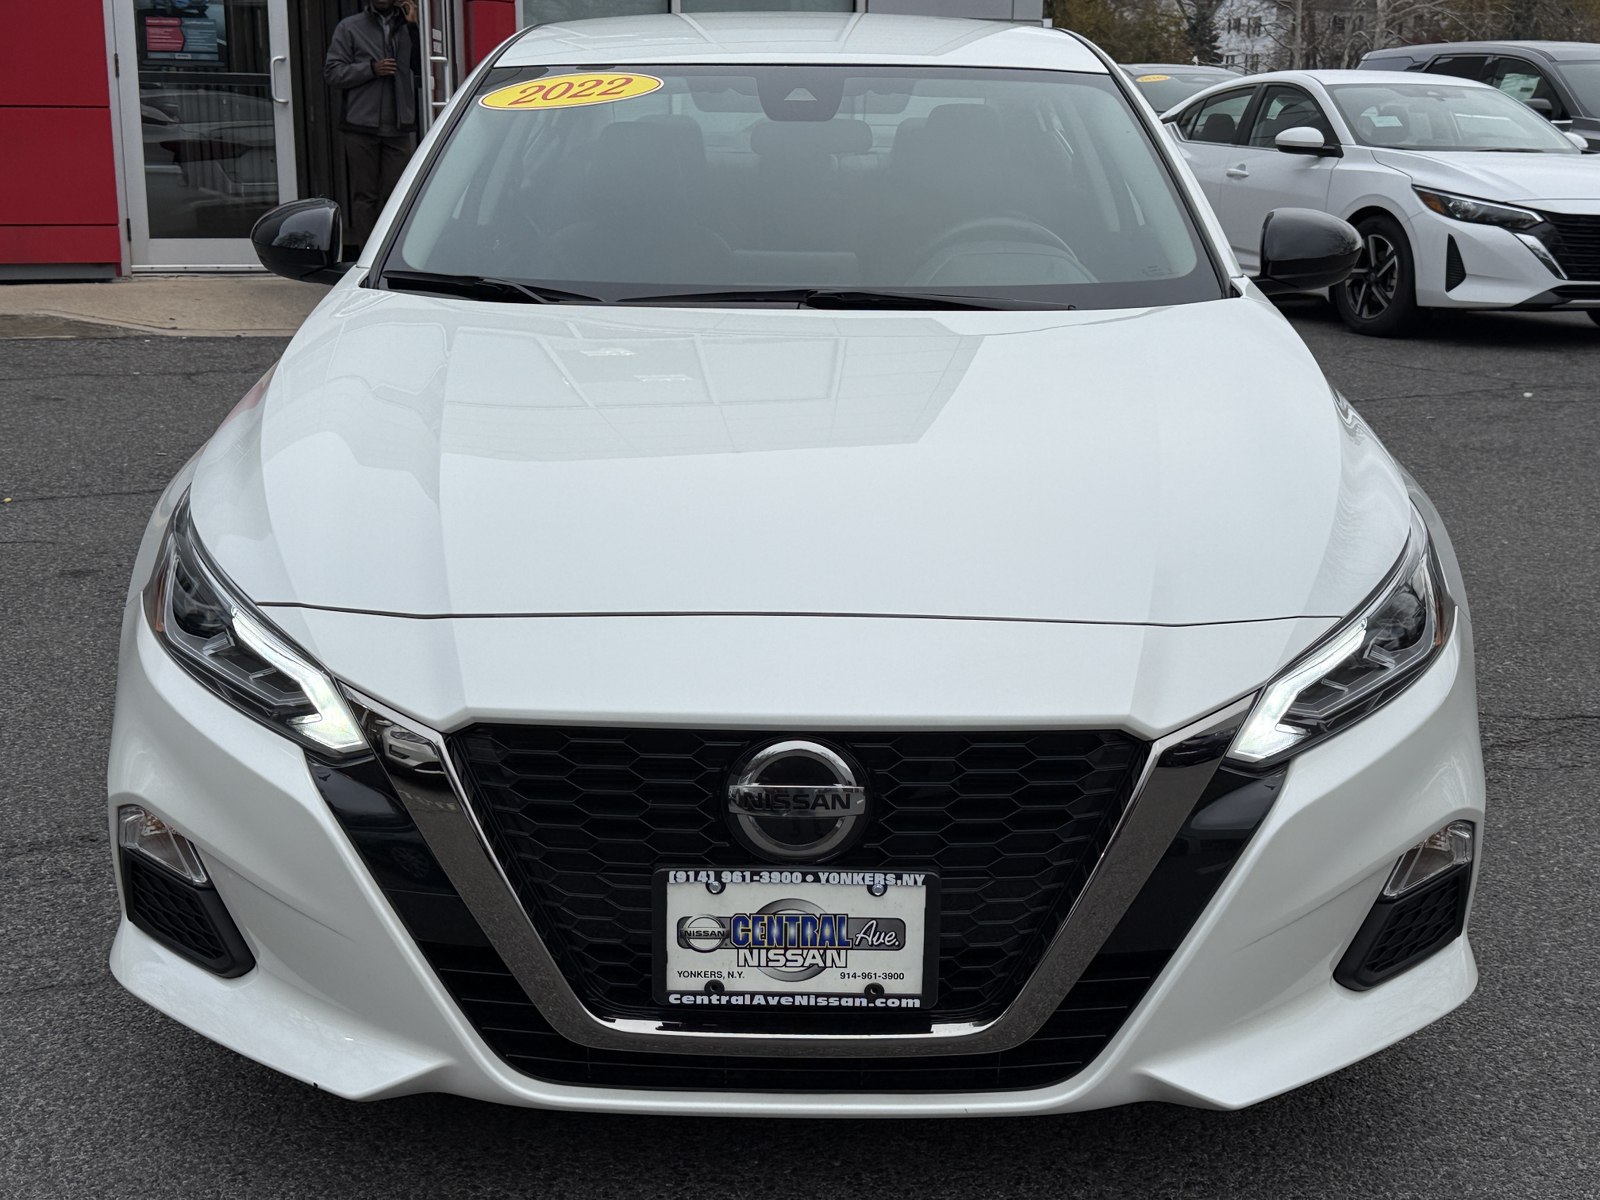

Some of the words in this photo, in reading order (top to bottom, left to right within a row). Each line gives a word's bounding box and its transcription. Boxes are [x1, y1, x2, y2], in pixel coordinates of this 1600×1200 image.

[508, 77, 634, 106] 2022
[743, 792, 851, 811] NISSAN
[721, 871, 803, 884] 961-3900
[818, 872, 926, 887] YONKERS,NY
[684, 930, 726, 938] NISSAN
[730, 913, 853, 949] CENTRAL
[854, 919, 900, 946] Ave.
[737, 948, 848, 969] NISSAN
[677, 970, 726, 980] YONKERS,
[727, 971, 745, 979] N.Y.
[839, 971, 905, 981] 914-961-3900
[668, 993, 921, 1008] CentralAveNissan.com
